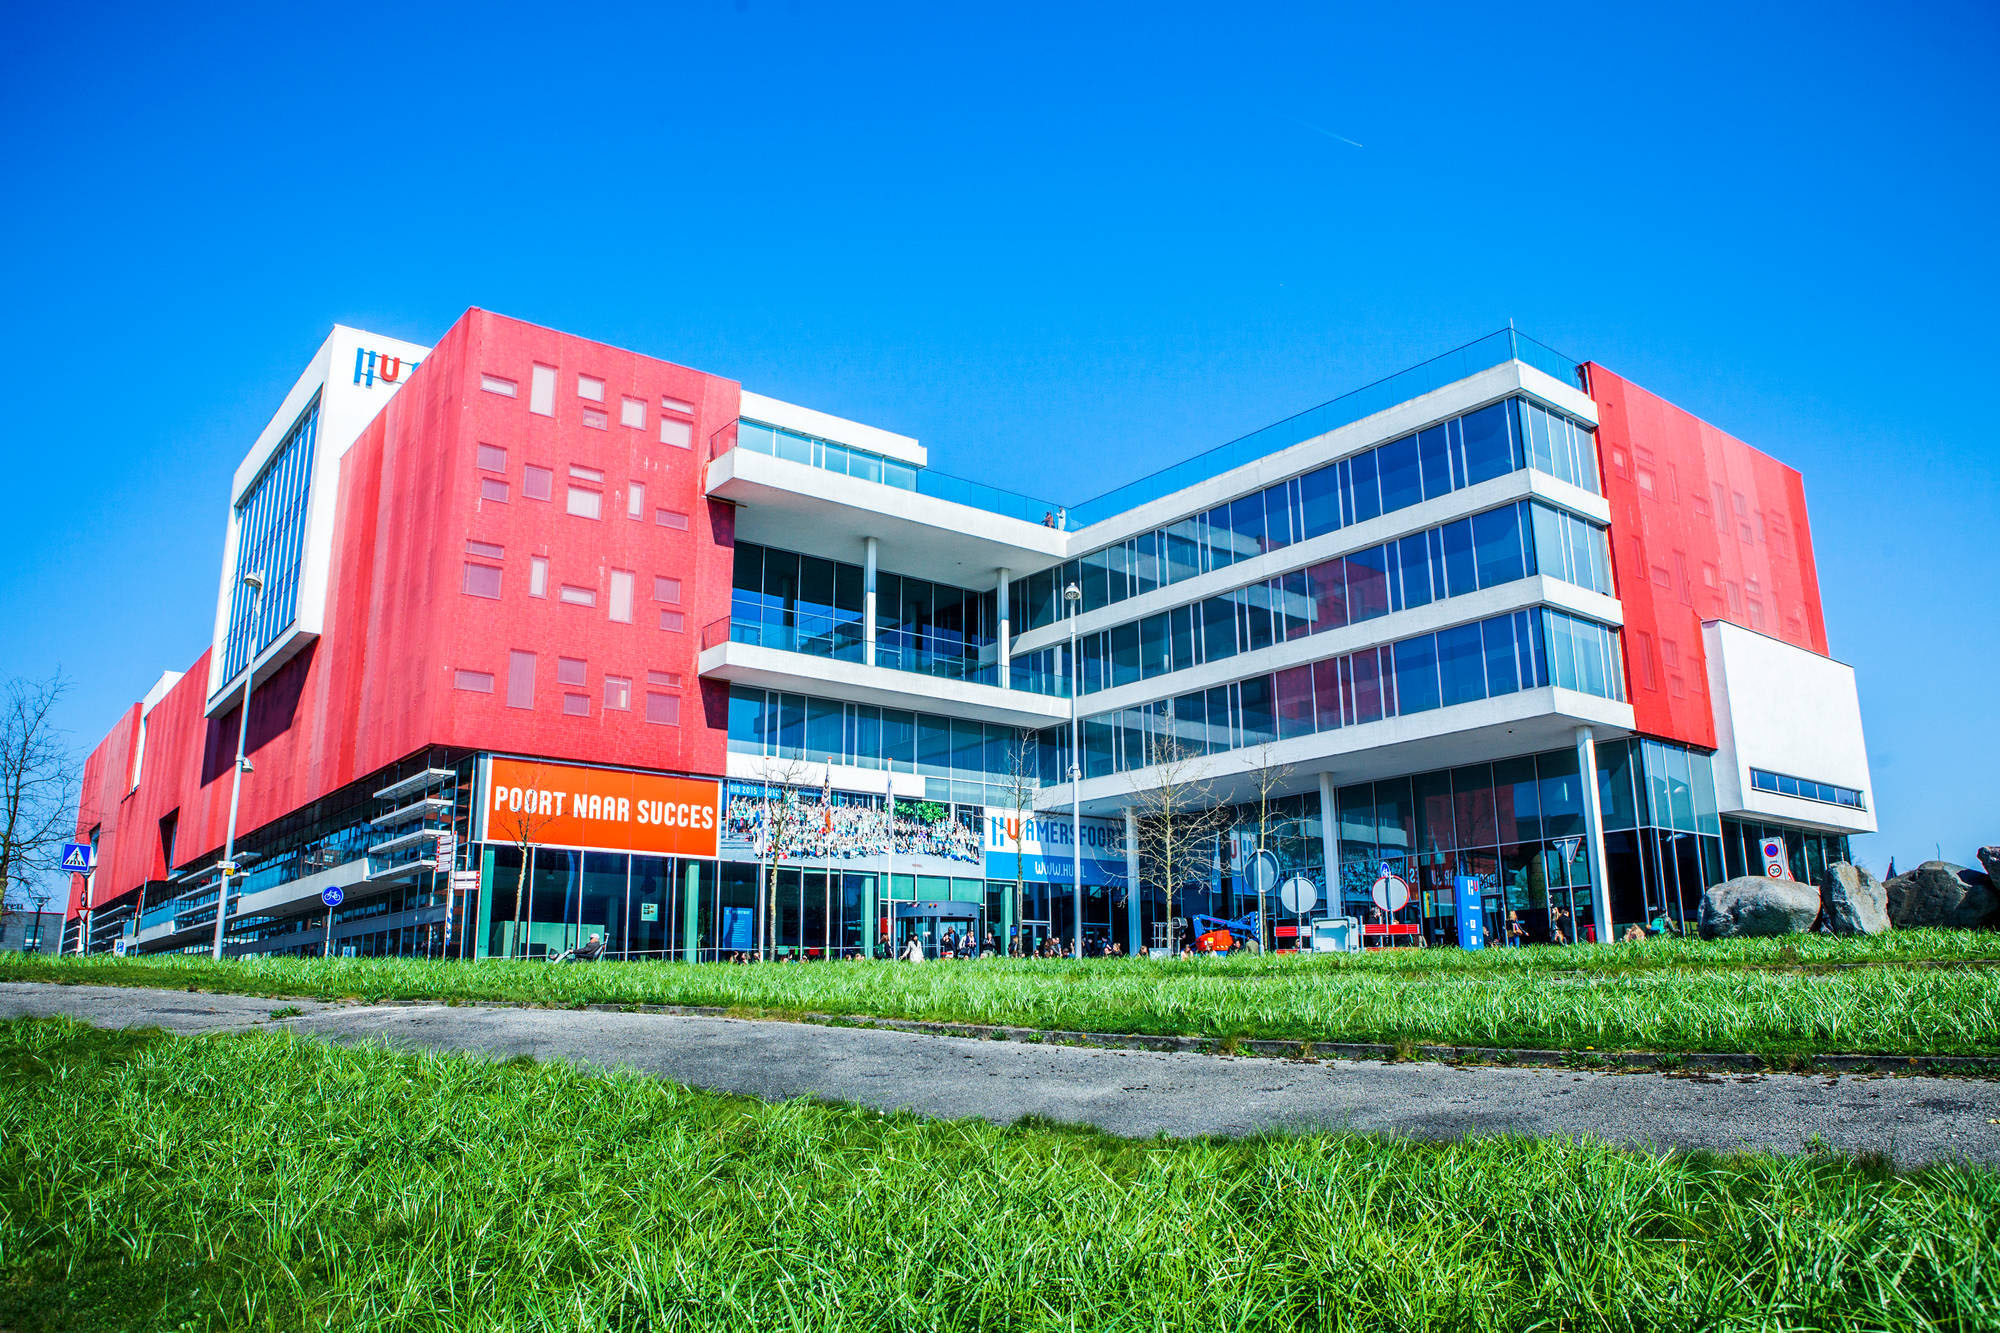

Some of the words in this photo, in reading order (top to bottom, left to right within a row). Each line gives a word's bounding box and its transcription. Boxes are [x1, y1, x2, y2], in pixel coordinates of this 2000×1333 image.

[353, 348, 400, 387] HU
[742, 785, 758, 795] 2015
[494, 786, 566, 816] POORT
[573, 793, 630, 822] NAAR
[637, 800, 713, 829] SUCCES
[992, 816, 1019, 847] HU
[1034, 861, 1087, 878] WWW.HUL
